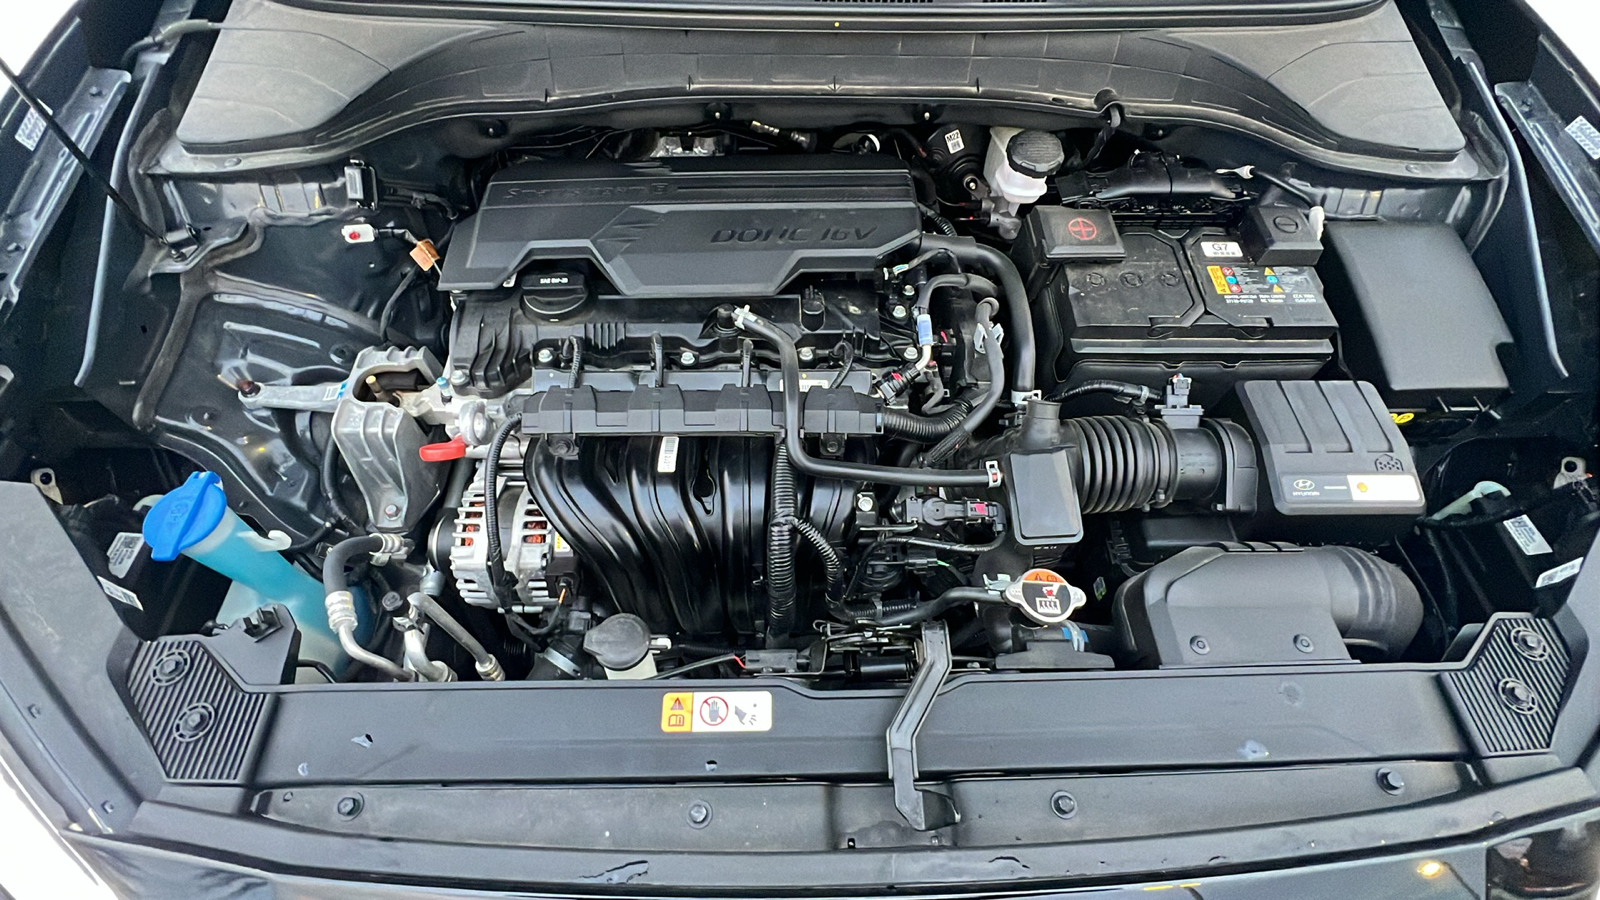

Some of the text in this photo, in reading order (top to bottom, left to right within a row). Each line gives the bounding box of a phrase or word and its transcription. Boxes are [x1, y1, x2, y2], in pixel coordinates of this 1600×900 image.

[946, 131, 960, 143] M22
[710, 226, 878, 244] DOHC 16V
[1212, 243, 1228, 251] G7
